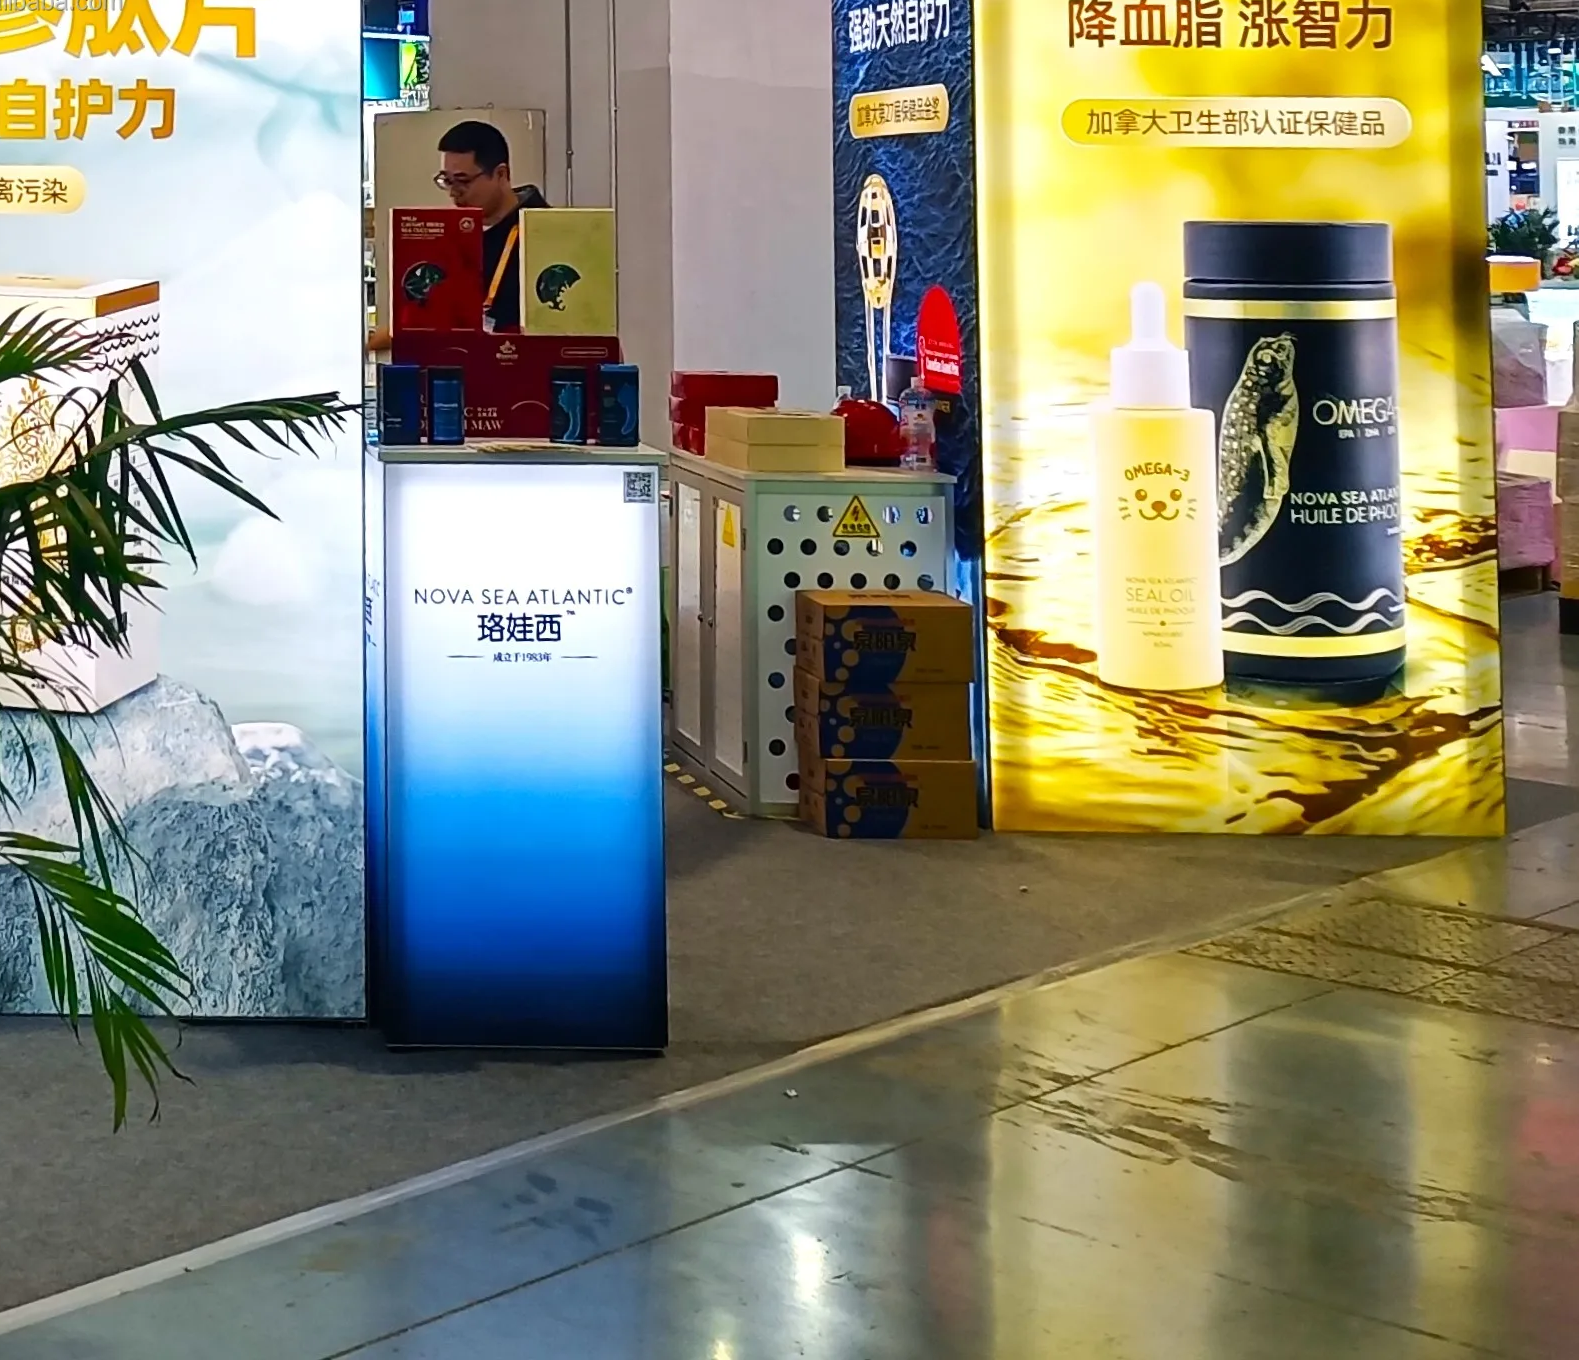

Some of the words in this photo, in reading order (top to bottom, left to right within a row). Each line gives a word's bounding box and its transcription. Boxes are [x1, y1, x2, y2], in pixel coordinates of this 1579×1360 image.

[1085, 108, 1386, 139] 加拿大卫生部认证保健品
[1124, 461, 1191, 483] OMEGA-3
[1290, 492, 1339, 505] NOVA
[1341, 490, 1369, 505] SEA
[1290, 507, 1343, 525] HUILE
[1345, 506, 1369, 524] DE
[414, 588, 475, 605] NOVA
[481, 588, 520, 605] SEA
[1125, 587, 1167, 603] SEAL
[1169, 588, 1196, 603] OIL
[492, 651, 553, 663] 成立于1983年
